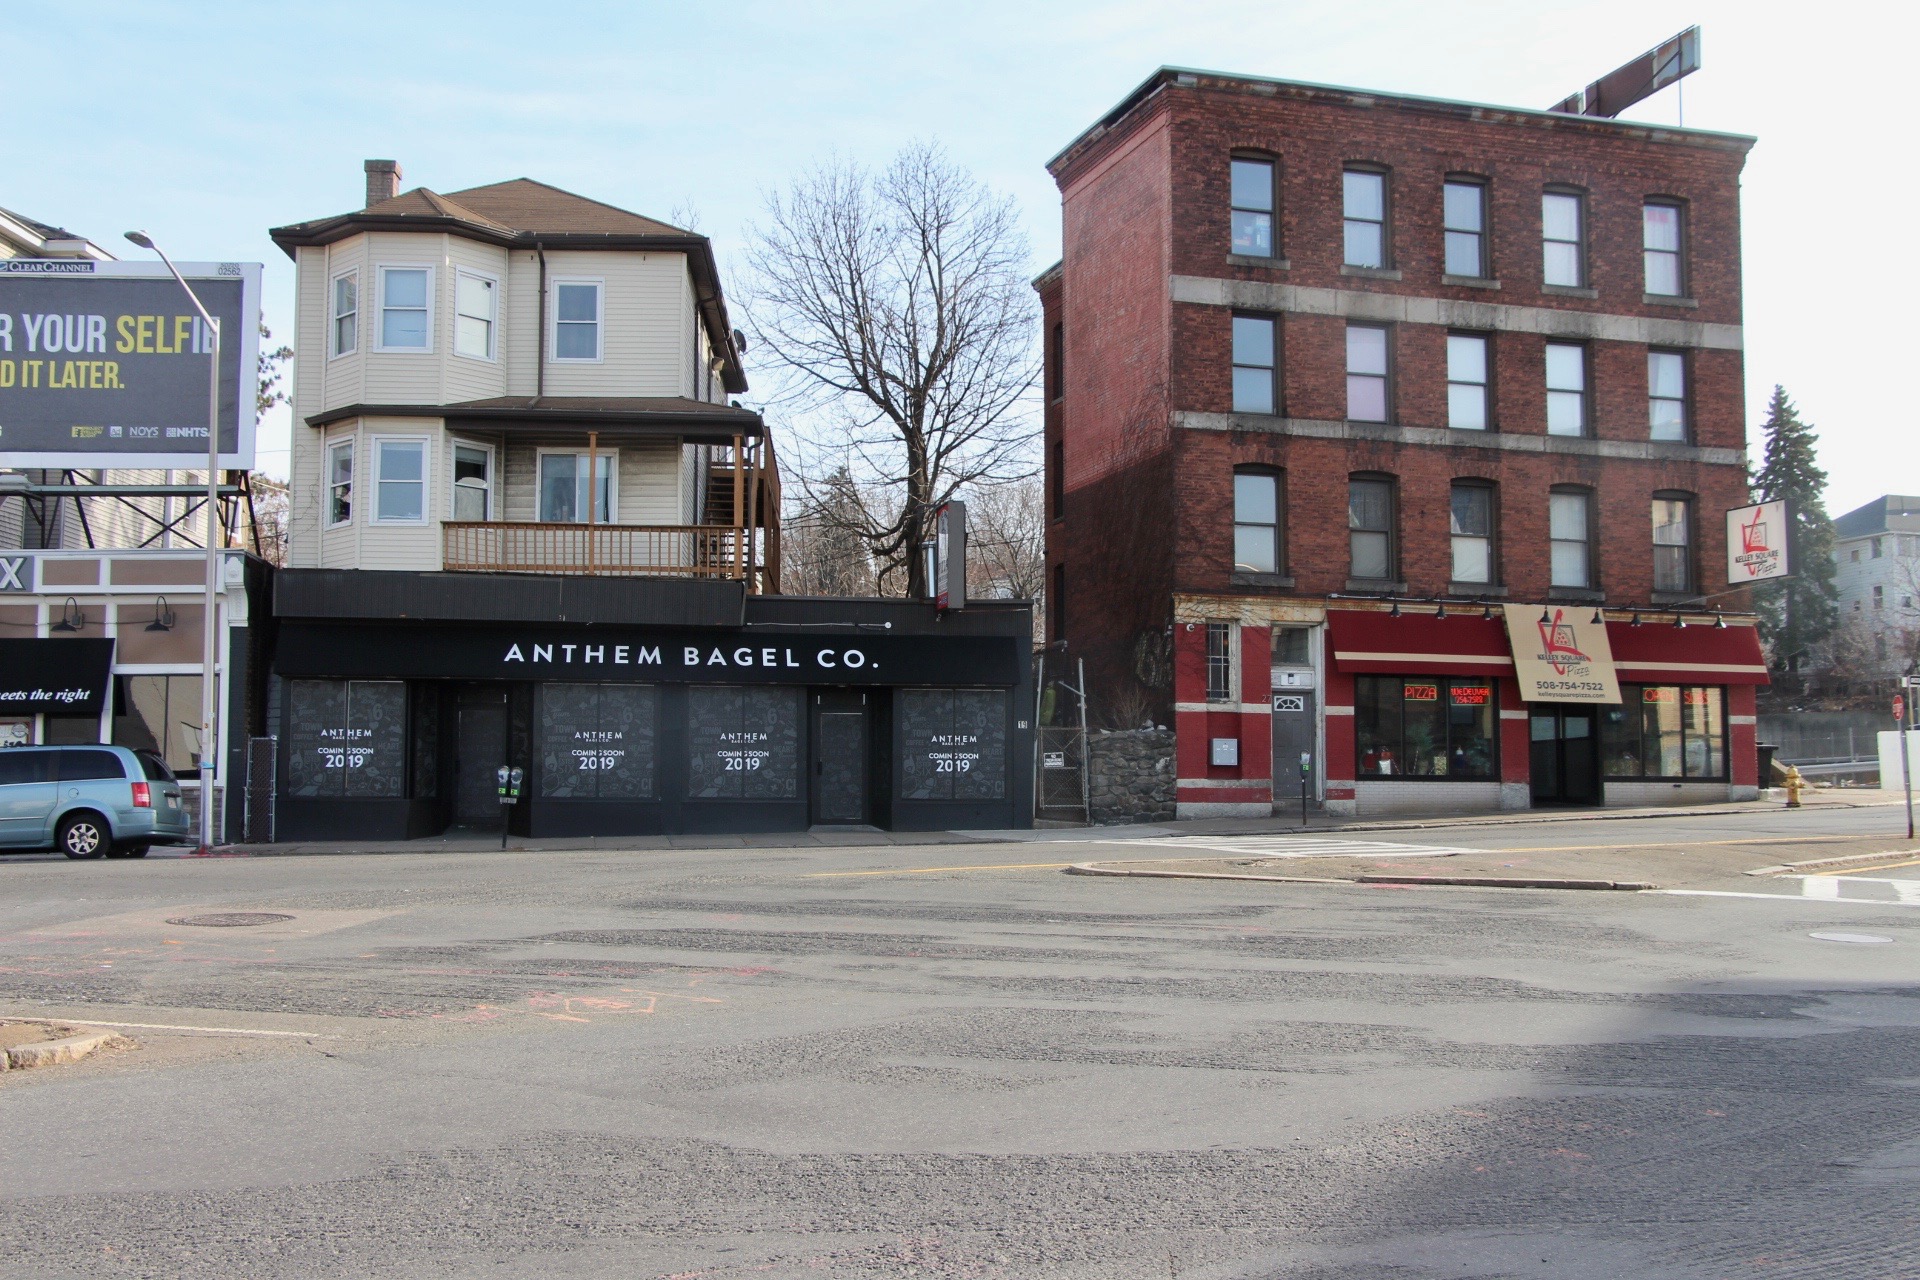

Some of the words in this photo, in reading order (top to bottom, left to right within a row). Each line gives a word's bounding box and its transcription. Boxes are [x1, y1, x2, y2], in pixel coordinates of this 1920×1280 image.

[217, 267, 241, 276] 02562
[22, 314, 107, 353] YOUR
[0, 360, 16, 388] D
[22, 361, 43, 388] IT
[49, 361, 125, 389] LATER.
[130, 426, 159, 438] NOYS
[1735, 554, 1753, 563] KELLEY
[1755, 549, 1779, 559] SQUARE
[504, 643, 663, 665] ANTHEM
[684, 647, 800, 667] BAGEL
[817, 649, 880, 668] CO.
[1567, 665, 1590, 677] Pizza
[1536, 681, 1604, 691] 508-754-7522
[0, 690, 28, 700] eets
[30, 688, 53, 700] the
[55, 689, 91, 703] right
[1405, 686, 1437, 699] PIZZA
[1538, 691, 1605, 699] kelleysquarepizza.com
[320, 729, 372, 737] ANTHEM
[575, 731, 623, 739] ANTHEM
[931, 735, 977, 743] ANTHEM
[325, 755, 364, 768] 2019
[579, 757, 615, 770] 2019
[725, 758, 760, 770] 2019
[936, 760, 970, 772] 2019
